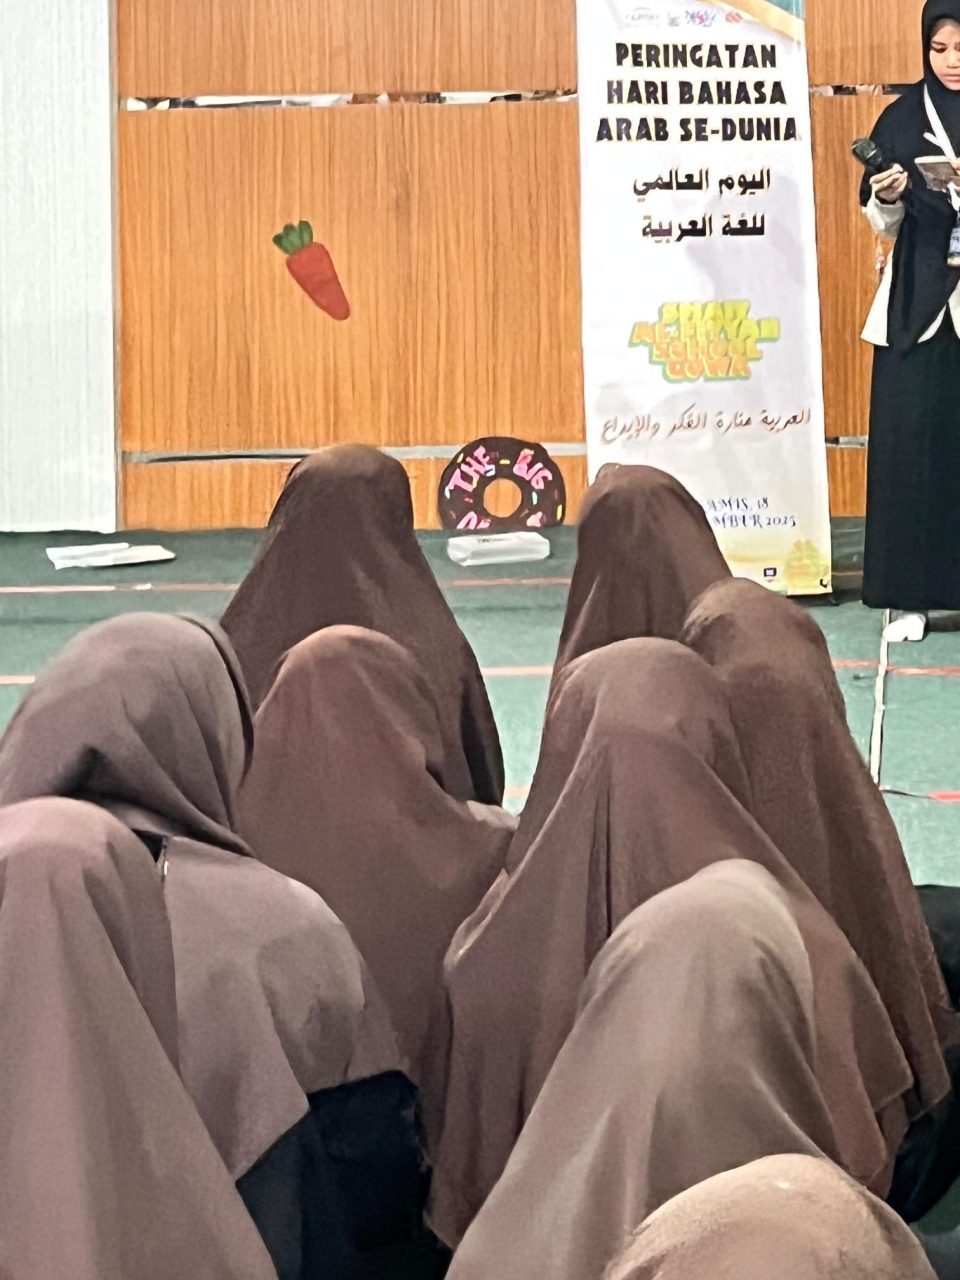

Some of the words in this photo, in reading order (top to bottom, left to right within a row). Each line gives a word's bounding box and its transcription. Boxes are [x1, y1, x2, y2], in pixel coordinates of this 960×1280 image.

[615, 42, 777, 68] PERINGATAN
[606, 79, 669, 105] HARI
[678, 80, 787, 105] BAHASA
[595, 117, 669, 142] ARAB
[679, 117, 798, 142] SE-DUNIA
[633, 166, 709, 203] العالمي
[718, 166, 771, 197] اليوم
[642, 213, 713, 244] العربية
[721, 211, 765, 237] للغة
[667, 402, 708, 438] الفكر
[715, 411, 752, 435] منارة
[760, 407, 811, 433] العربية
[448, 445, 495, 493] THE
